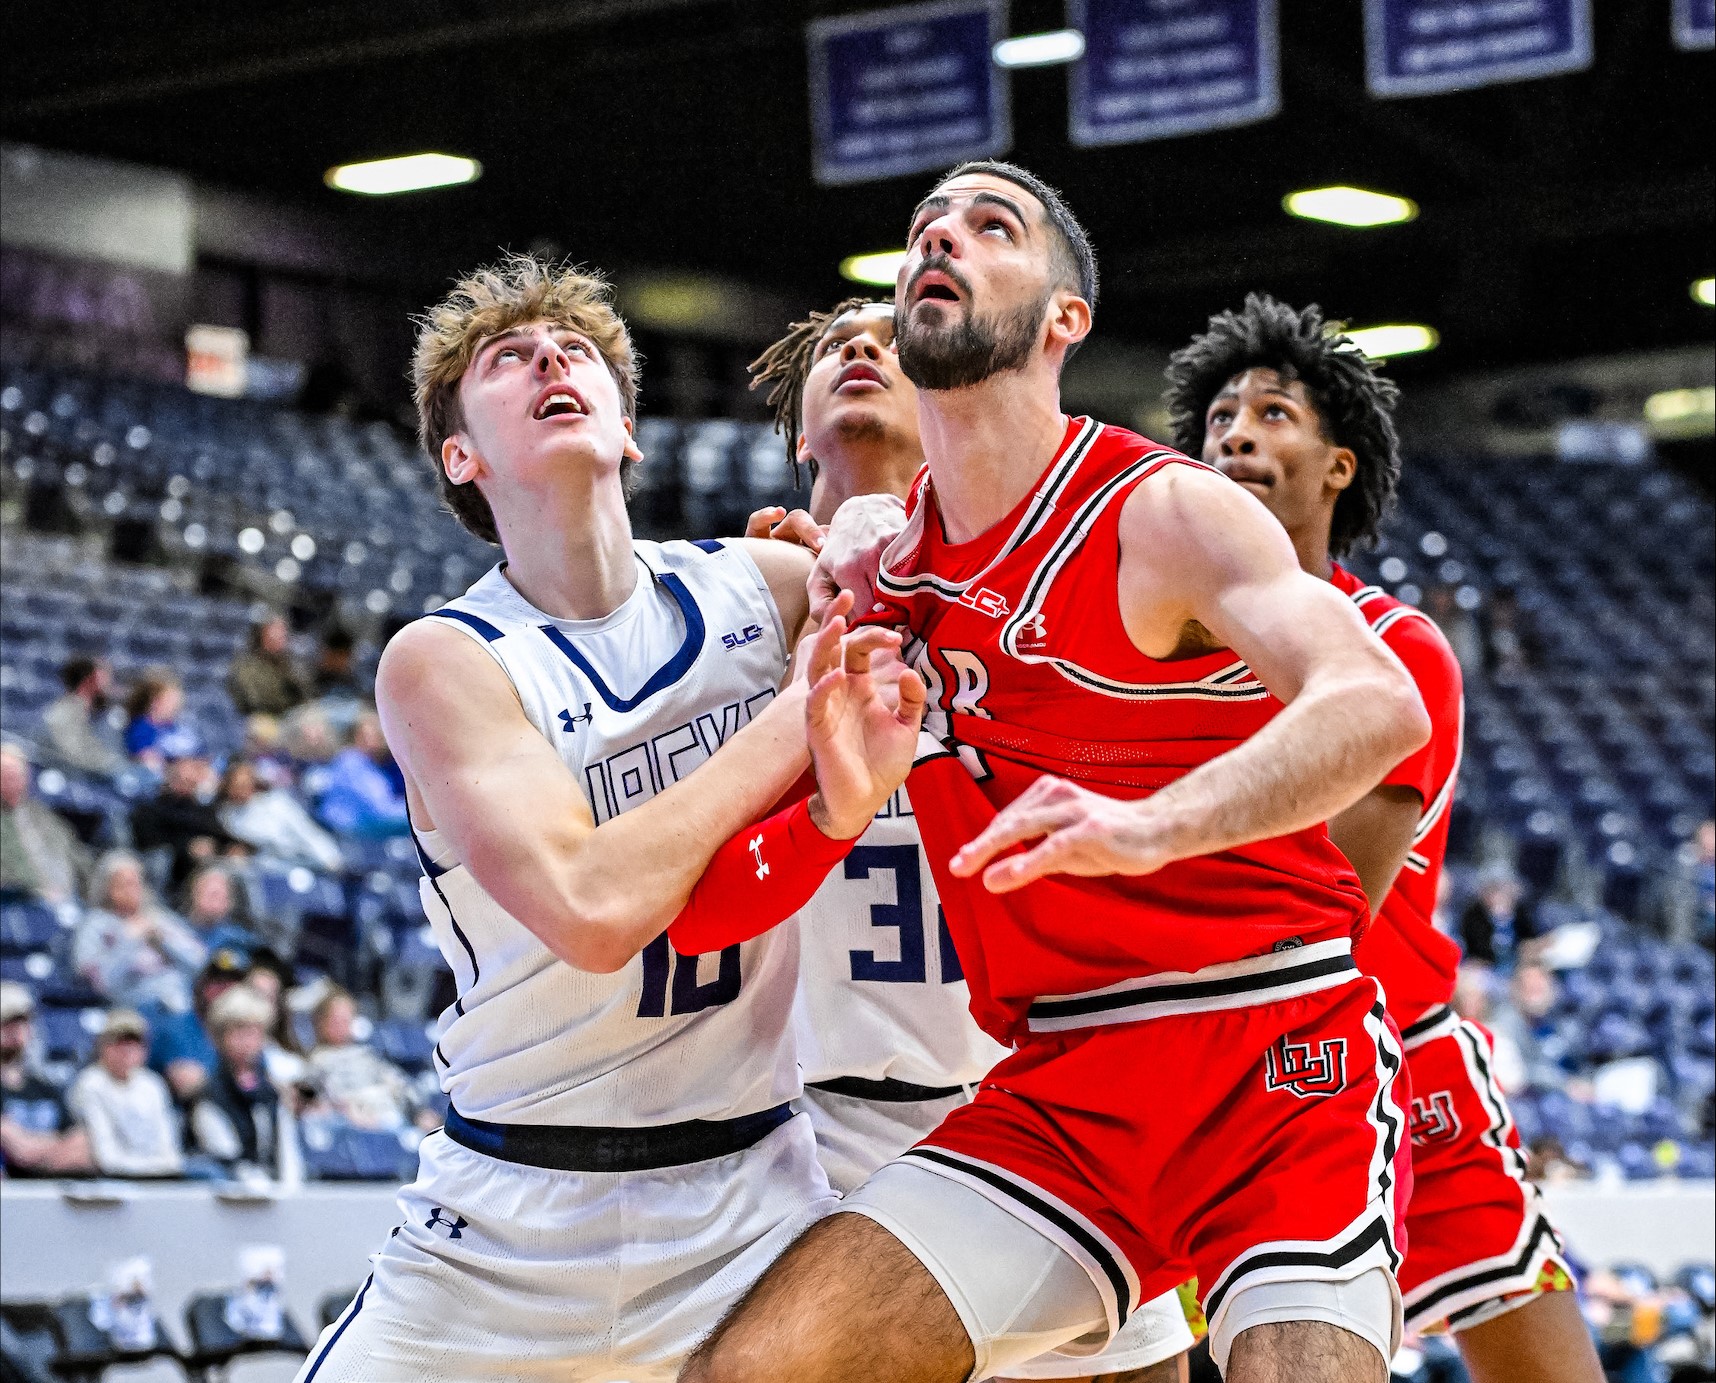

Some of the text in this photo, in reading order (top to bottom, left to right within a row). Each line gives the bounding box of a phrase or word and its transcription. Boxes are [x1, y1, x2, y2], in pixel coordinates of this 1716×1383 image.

[721, 624, 763, 649] SLC
[844, 844, 965, 984] 3
[1265, 1033, 1348, 1099] LU
